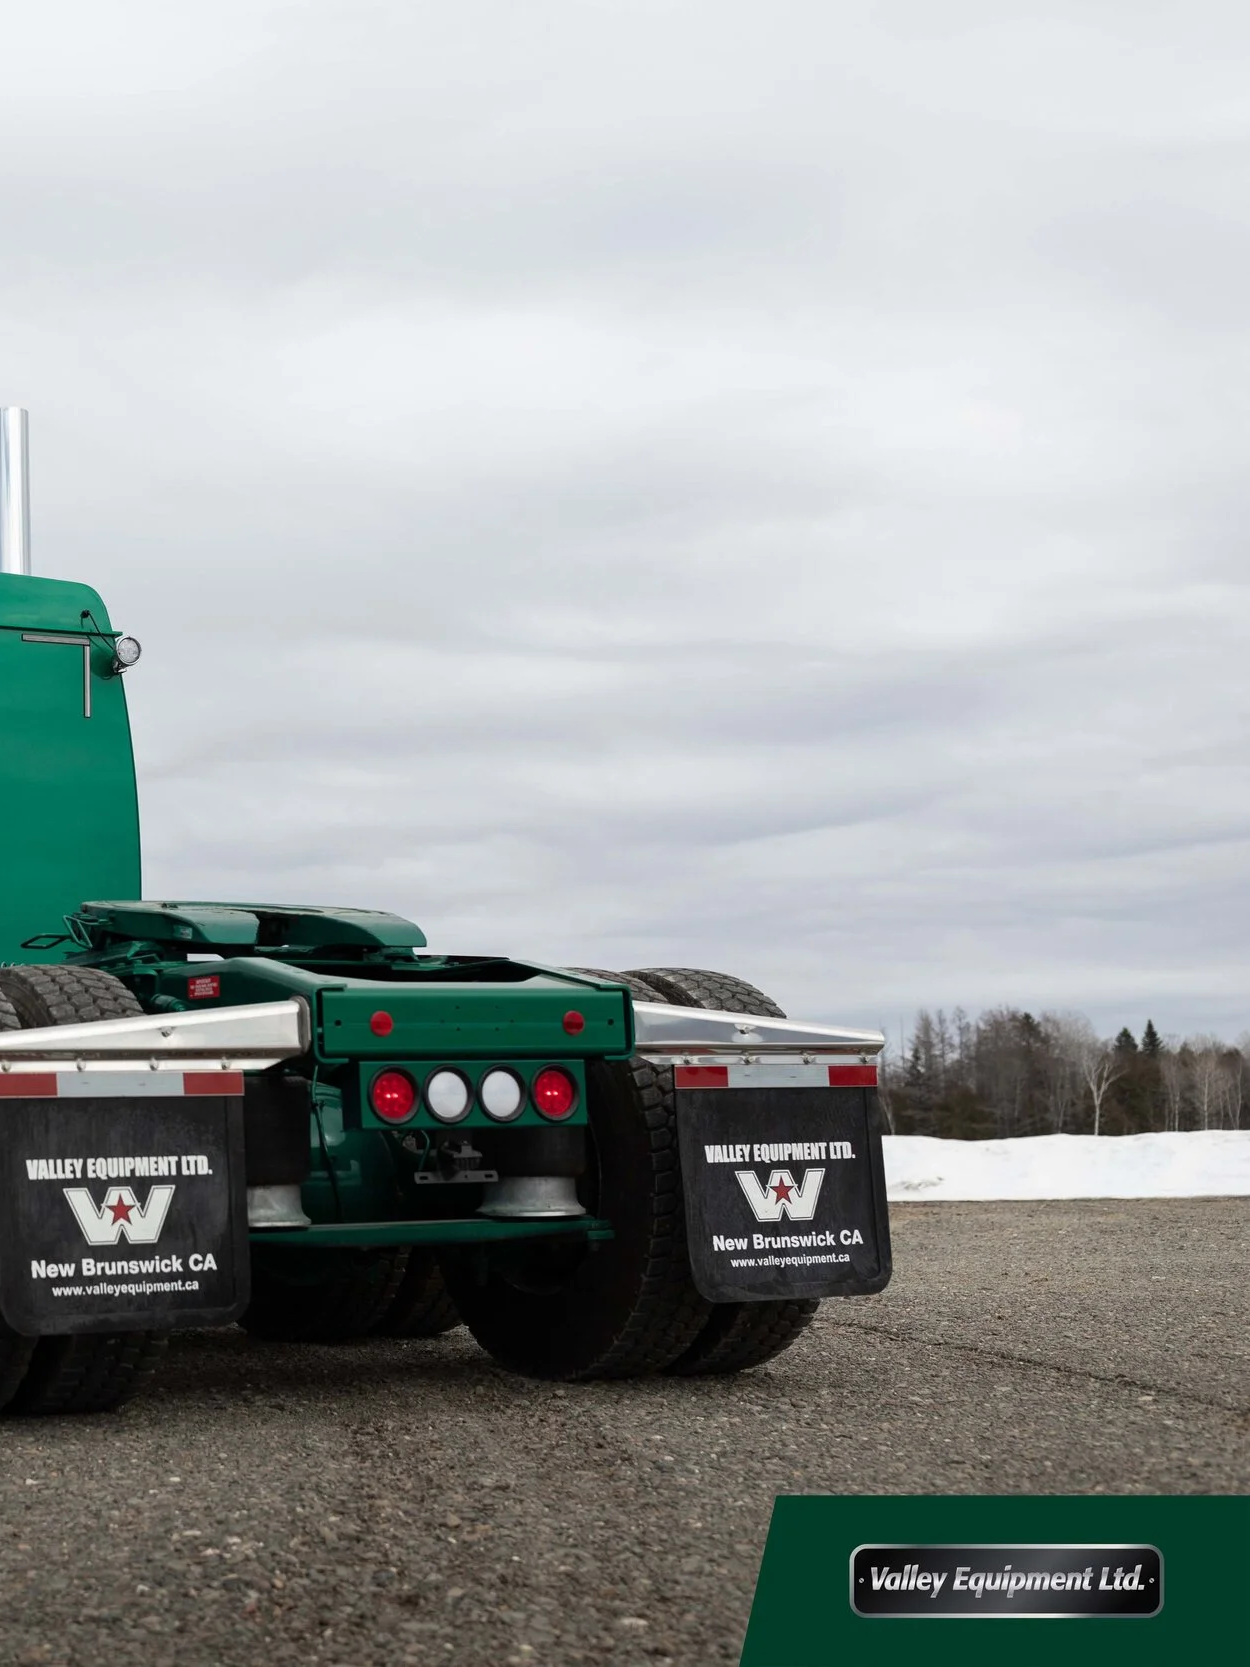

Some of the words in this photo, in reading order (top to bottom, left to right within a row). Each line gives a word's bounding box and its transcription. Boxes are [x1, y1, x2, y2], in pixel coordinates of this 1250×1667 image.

[704, 1144, 751, 1164] VALLEY
[753, 1142, 827, 1163] EQUIPMENT
[829, 1141, 856, 1160] LTD.
[25, 1158, 83, 1180] VALLEY
[86, 1156, 178, 1180] EQUIPMENT
[181, 1155, 213, 1176] LTD.
[712, 1234, 748, 1251] New
[752, 1231, 836, 1250] Brunswick
[839, 1229, 864, 1246] CA
[30, 1260, 76, 1279] New
[81, 1254, 184, 1277] Brunswick
[188, 1253, 218, 1271] CA
[730, 1253, 850, 1269] www.valleyequipment.ca
[51, 1279, 200, 1297] www.valleyequipment.ca
